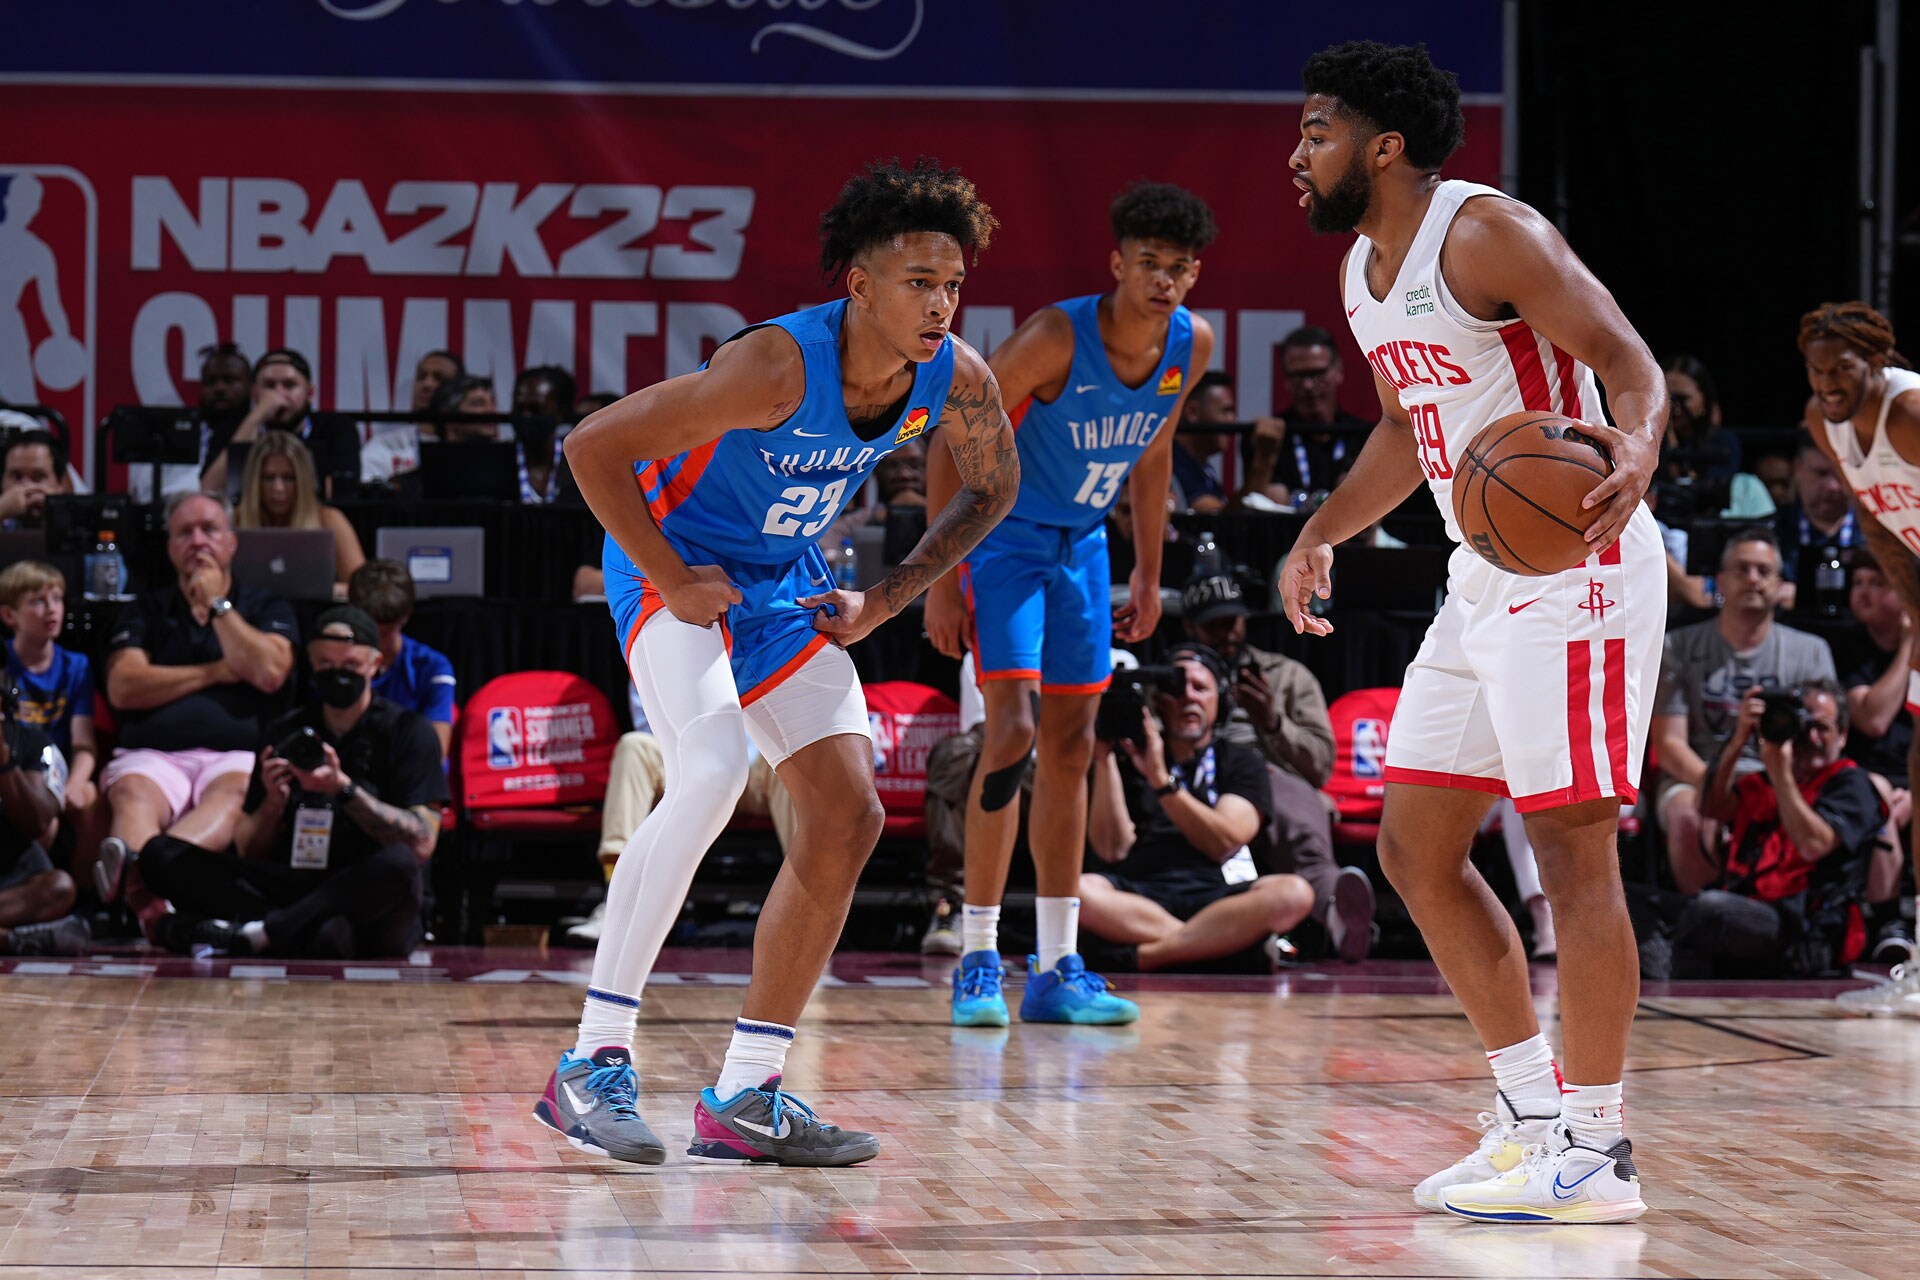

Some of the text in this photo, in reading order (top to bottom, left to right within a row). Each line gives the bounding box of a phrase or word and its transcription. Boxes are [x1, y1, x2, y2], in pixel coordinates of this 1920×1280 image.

[1405, 286, 1431, 302] credit
[1405, 301, 1435, 317] karma
[130, 291, 756, 425] SMME
[1367, 340, 1472, 391] OCKETS
[759, 446, 895, 478] THUND
[1073, 460, 1130, 509] 13
[761, 477, 848, 537] 23
